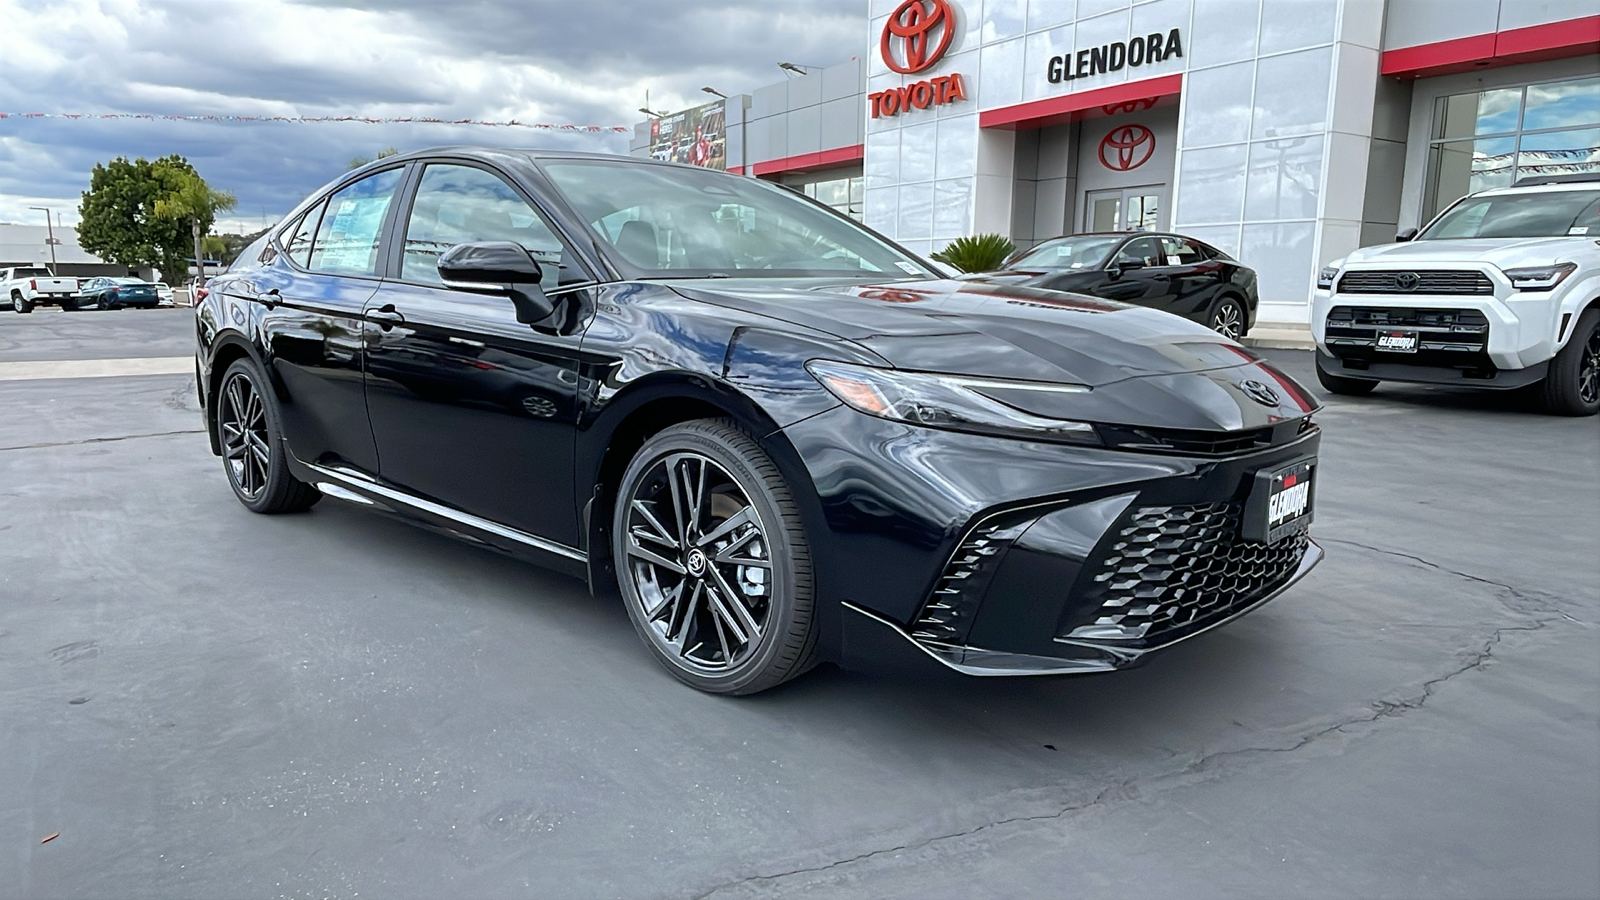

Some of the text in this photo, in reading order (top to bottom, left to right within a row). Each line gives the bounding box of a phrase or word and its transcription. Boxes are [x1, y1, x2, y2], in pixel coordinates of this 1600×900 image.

[1047, 28, 1183, 84] GLENDORA
[868, 73, 967, 119] TOYOTA
[1378, 336, 1416, 349] GLENDORA
[1268, 481, 1310, 525] GLENDORA
